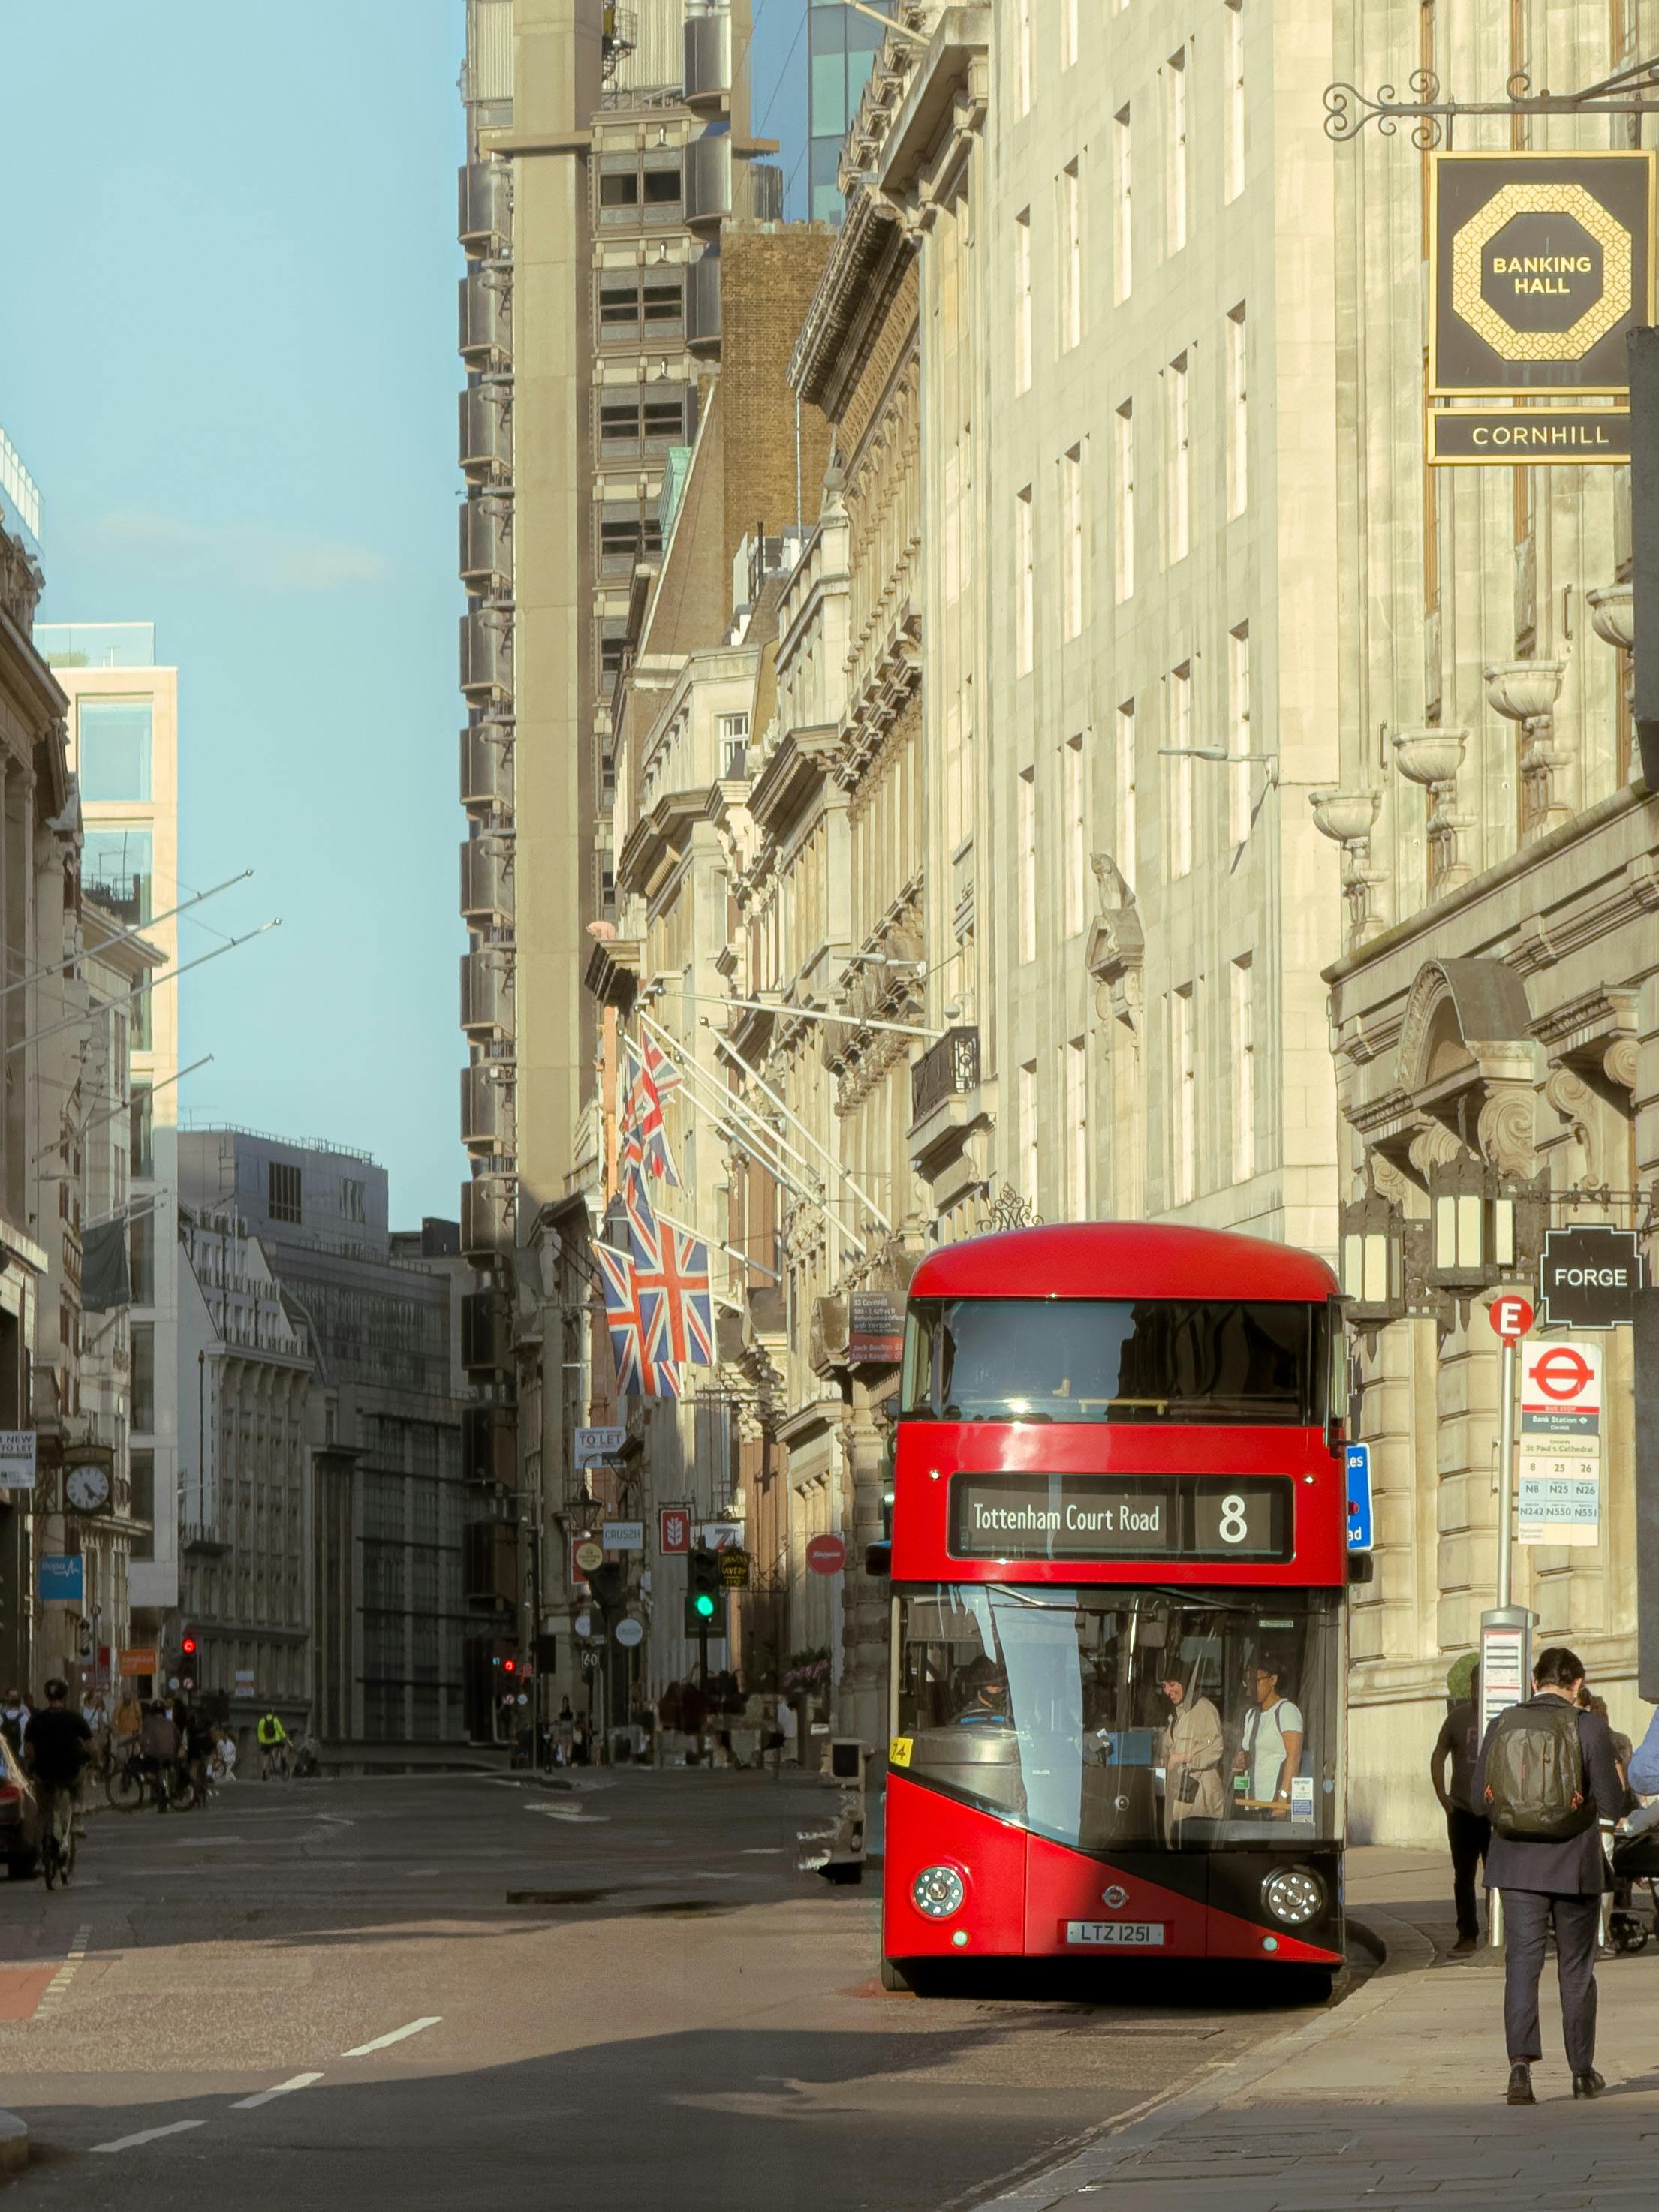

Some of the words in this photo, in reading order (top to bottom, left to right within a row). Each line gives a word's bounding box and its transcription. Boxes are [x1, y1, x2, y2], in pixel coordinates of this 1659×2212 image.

[1492, 257, 1591, 273] BANKING
[1514, 278, 1570, 293] HALL
[1471, 426, 1610, 445] CORNHILL
[1555, 1268, 1628, 1287] FORGE
[1499, 1302, 1522, 1335] E
[1532, 1415, 1549, 1423] Bank
[1551, 1416, 1577, 1424] Station
[6, 1435, 32, 1443] NEW
[580, 1434, 595, 1446] TO
[600, 1434, 622, 1445] LET
[1536, 1444, 1558, 1452] Paul's
[1558, 1445, 1594, 1453] Cathedral
[1529, 1462, 1536, 1472] 8
[1554, 1464, 1566, 1473] 25
[1580, 1464, 1593, 1473] 26
[1525, 1485, 1540, 1494] N8
[1549, 1485, 1569, 1494] N25
[1576, 1485, 1597, 1495] N26
[1519, 1507, 1544, 1516] N242
[1546, 1507, 1572, 1516] N550
[1574, 1508, 1597, 1518] N551
[973, 1503, 1061, 1530] Tottenham
[1065, 1504, 1113, 1531] Court
[1119, 1505, 1160, 1532] Road
[1218, 1494, 1248, 1544] 8
[1081, 1924, 1115, 1941] LTZ
[1119, 1925, 1151, 1943] 1251
